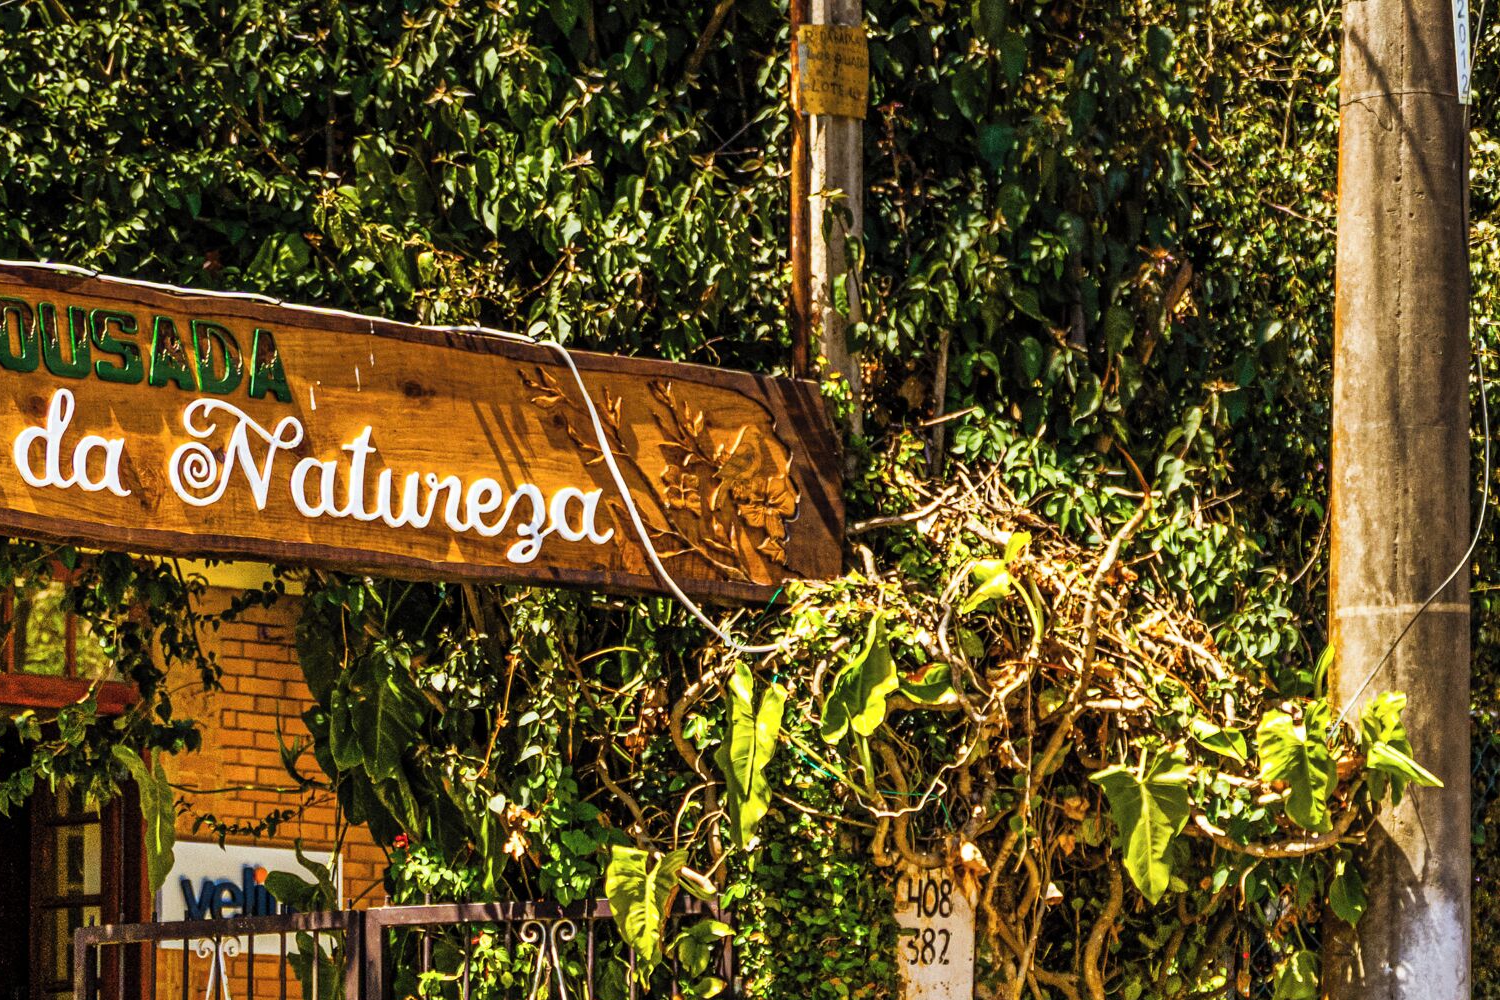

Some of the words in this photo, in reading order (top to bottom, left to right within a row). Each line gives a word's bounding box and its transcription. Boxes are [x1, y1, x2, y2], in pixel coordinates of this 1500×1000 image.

[14, 388, 132, 497] da
[169, 397, 615, 564] Natureza
[908, 878, 953, 918] 408
[905, 927, 951, 965] 382
